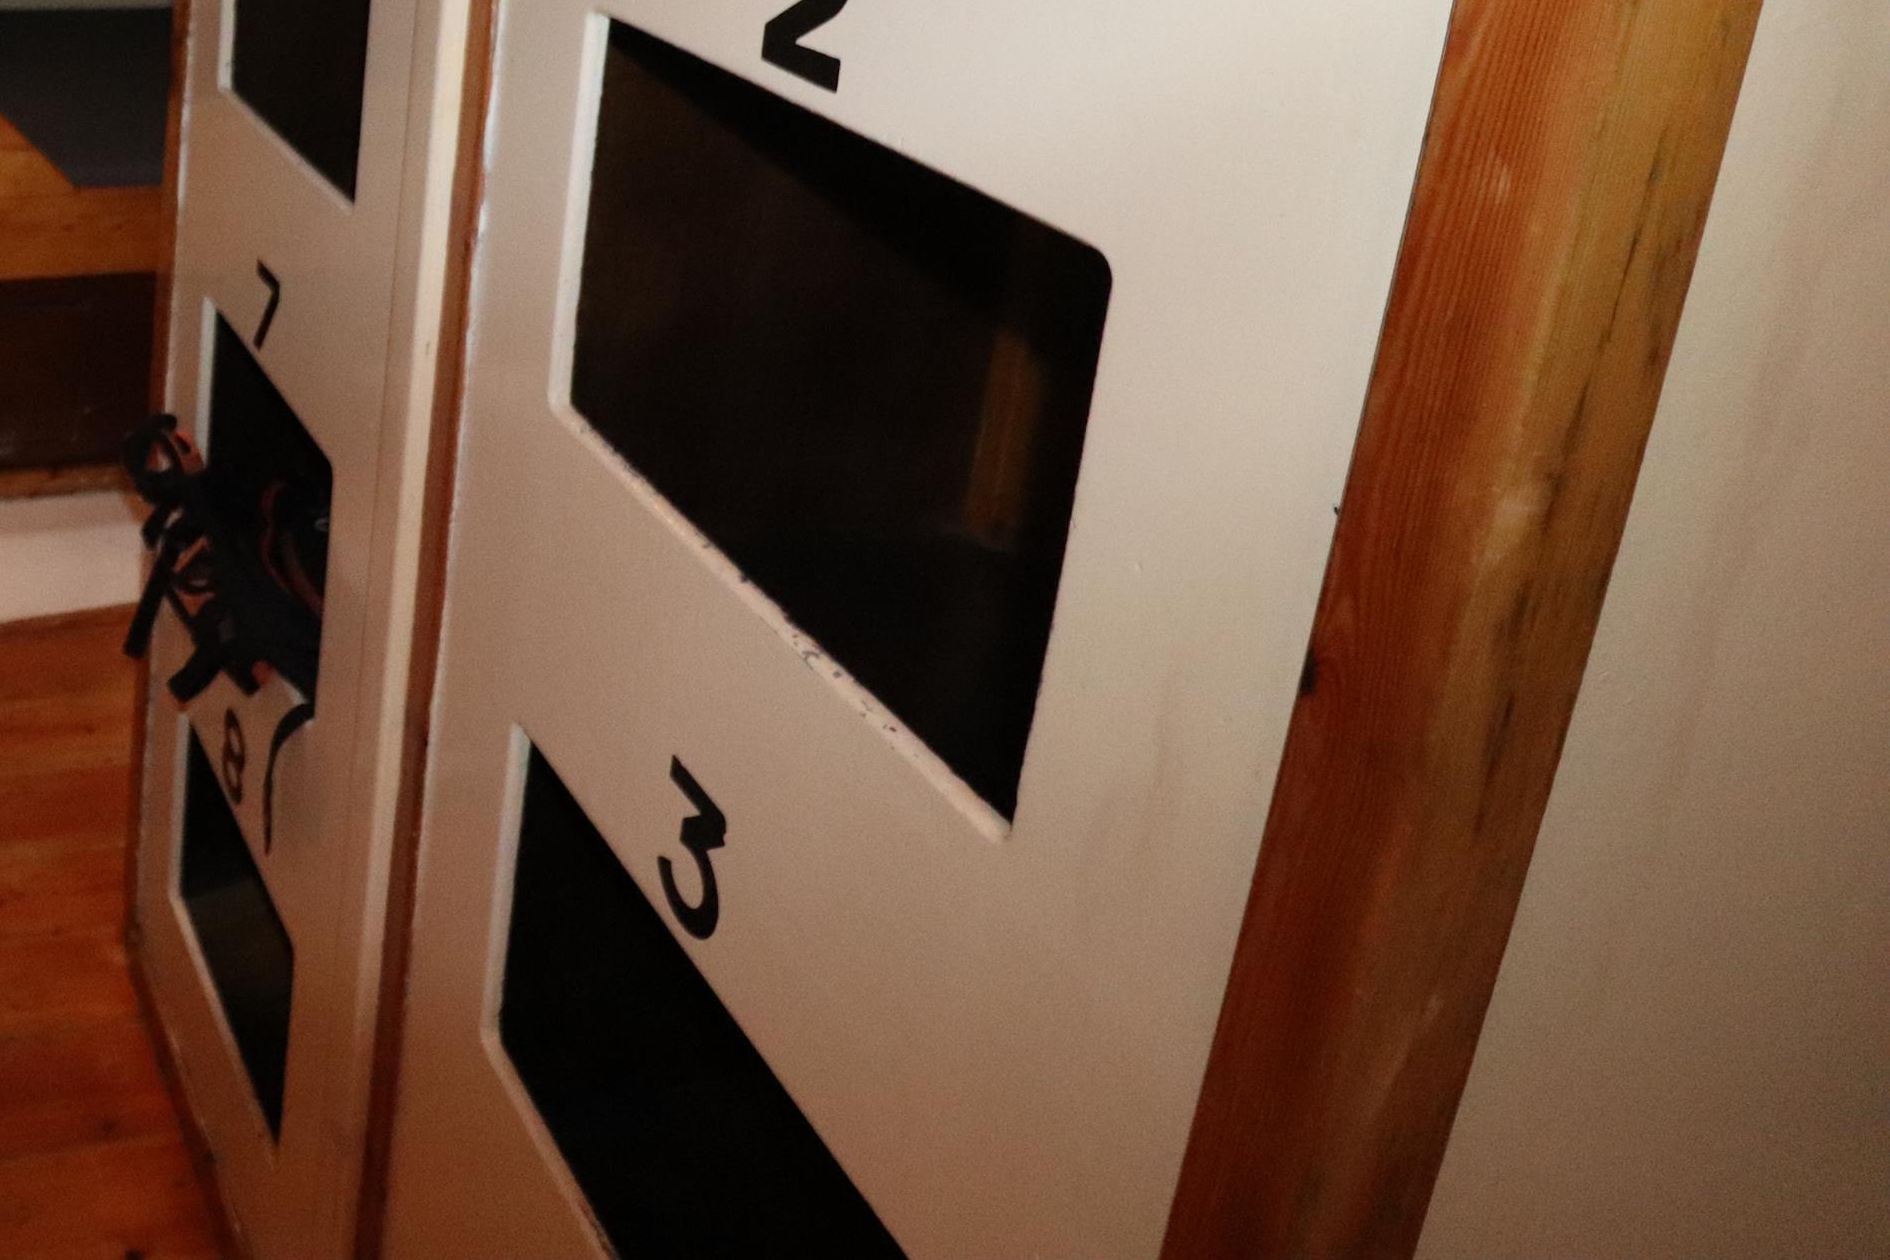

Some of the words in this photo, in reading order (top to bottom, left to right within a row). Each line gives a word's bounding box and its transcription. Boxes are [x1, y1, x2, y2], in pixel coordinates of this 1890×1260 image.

[253, 260, 280, 350] 7
[222, 709, 246, 805] 8
[658, 756, 726, 940] 3
